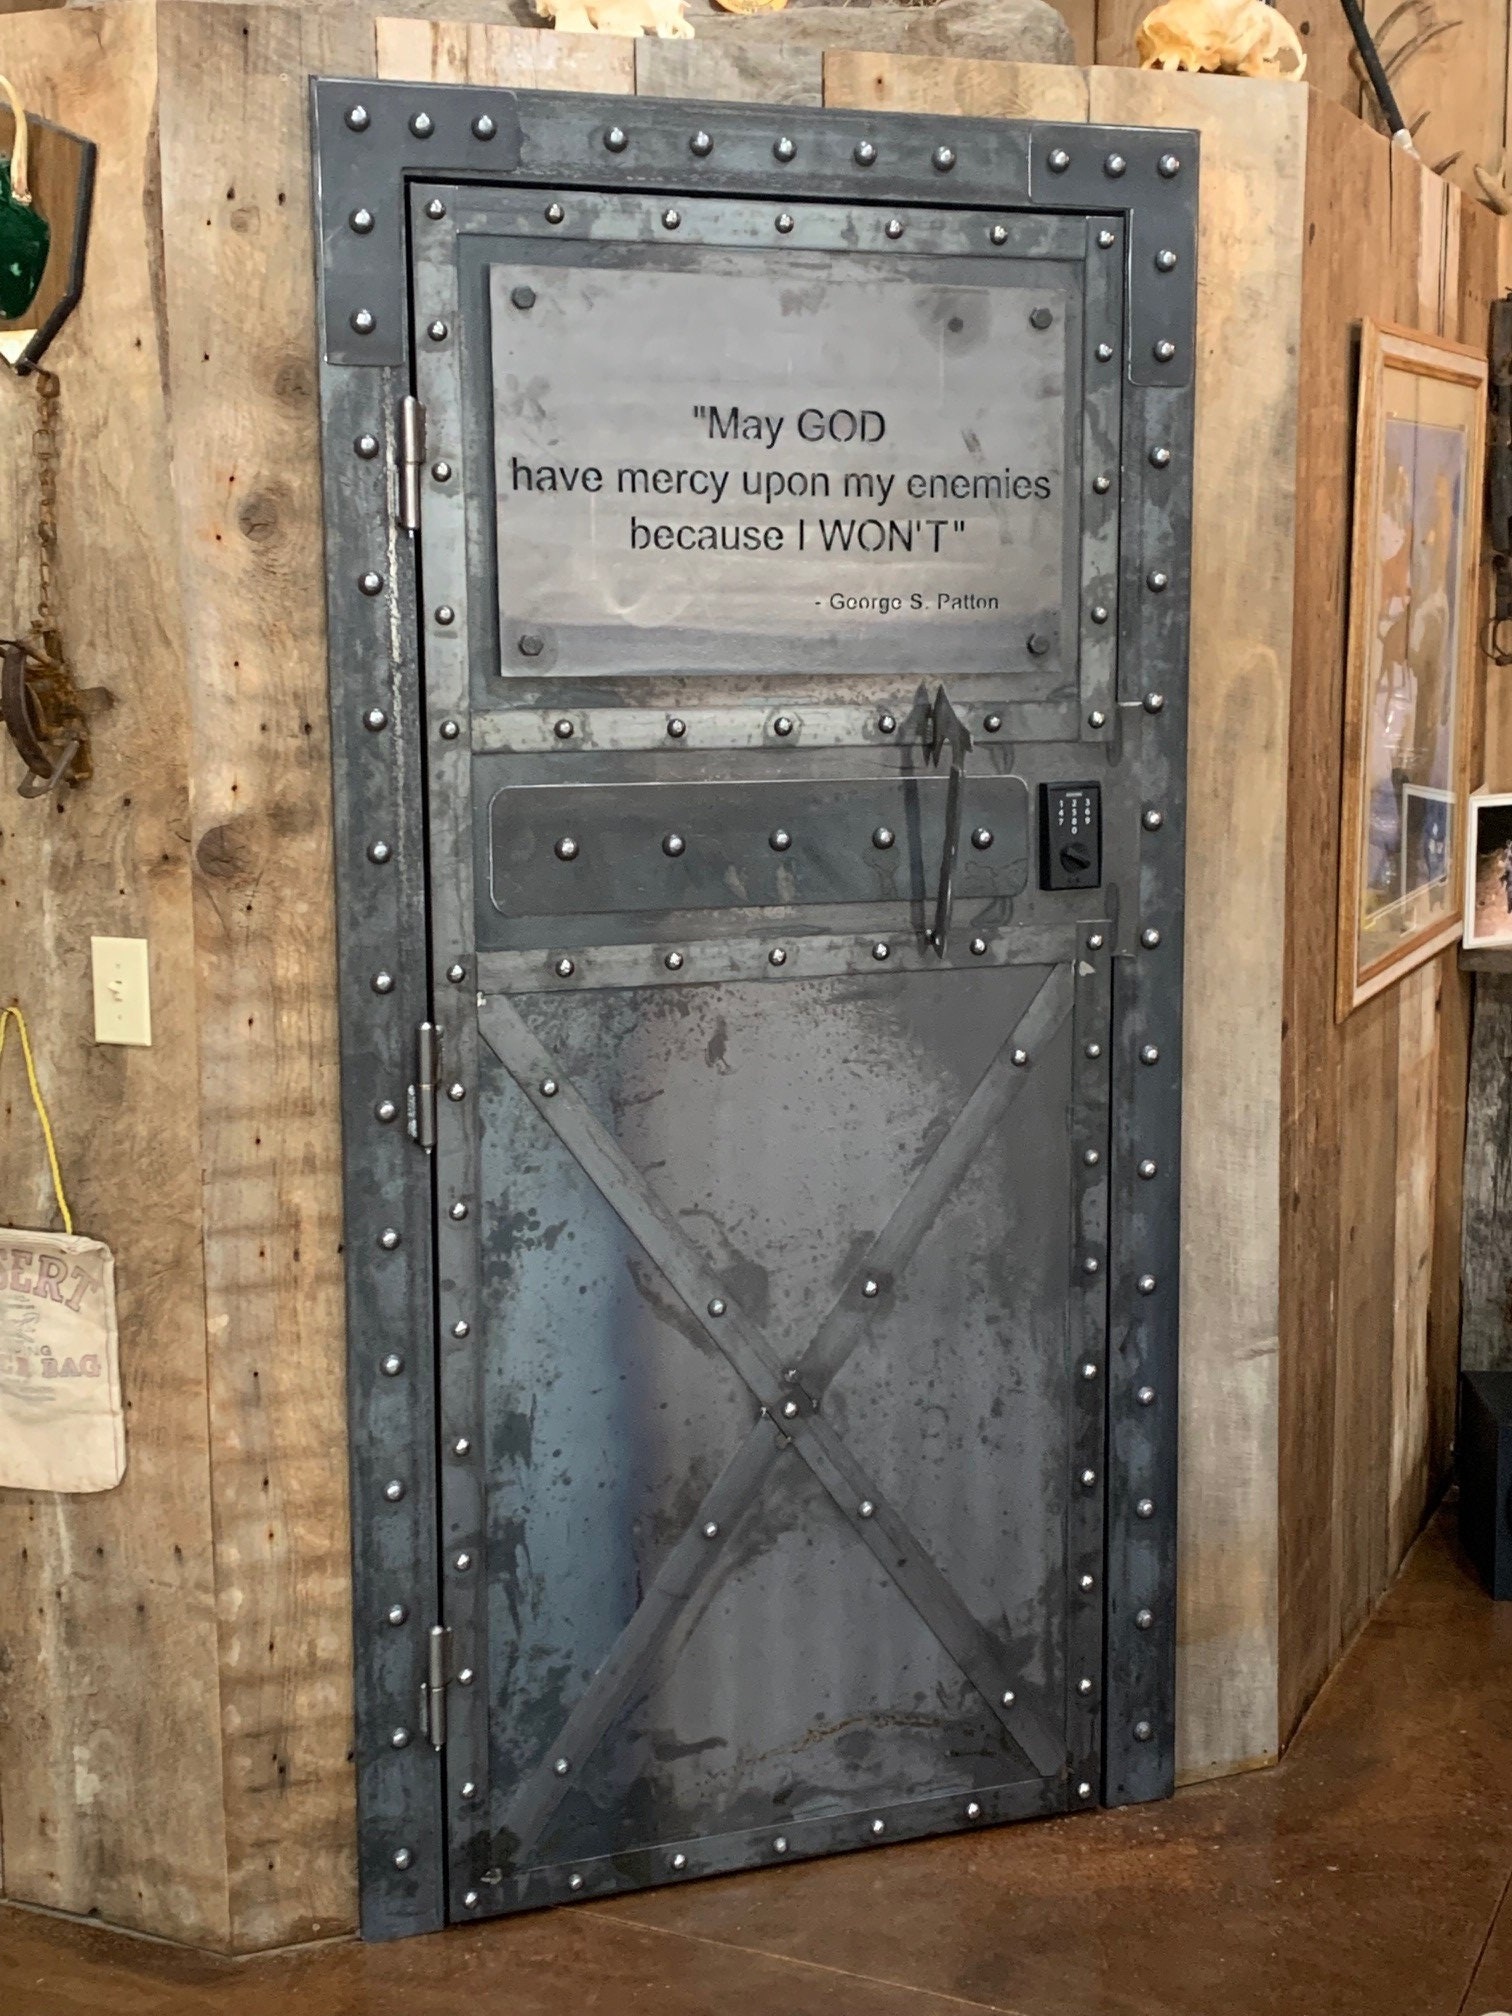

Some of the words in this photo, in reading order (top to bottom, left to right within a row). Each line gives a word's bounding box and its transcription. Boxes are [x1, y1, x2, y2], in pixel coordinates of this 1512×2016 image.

[693, 405, 784, 449] "May
[797, 408, 886, 443] GOD
[511, 456, 603, 493] have
[617, 467, 729, 504] mercy
[742, 471, 830, 504] upon
[844, 472, 896, 507] my
[906, 467, 1052, 500] enemies
[630, 515, 785, 552] because
[798, 518, 805, 551] I
[818, 518, 966, 554] WON'T"
[829, 592, 902, 615] George
[910, 593, 930, 611] S.
[937, 593, 1000, 611] Patton
